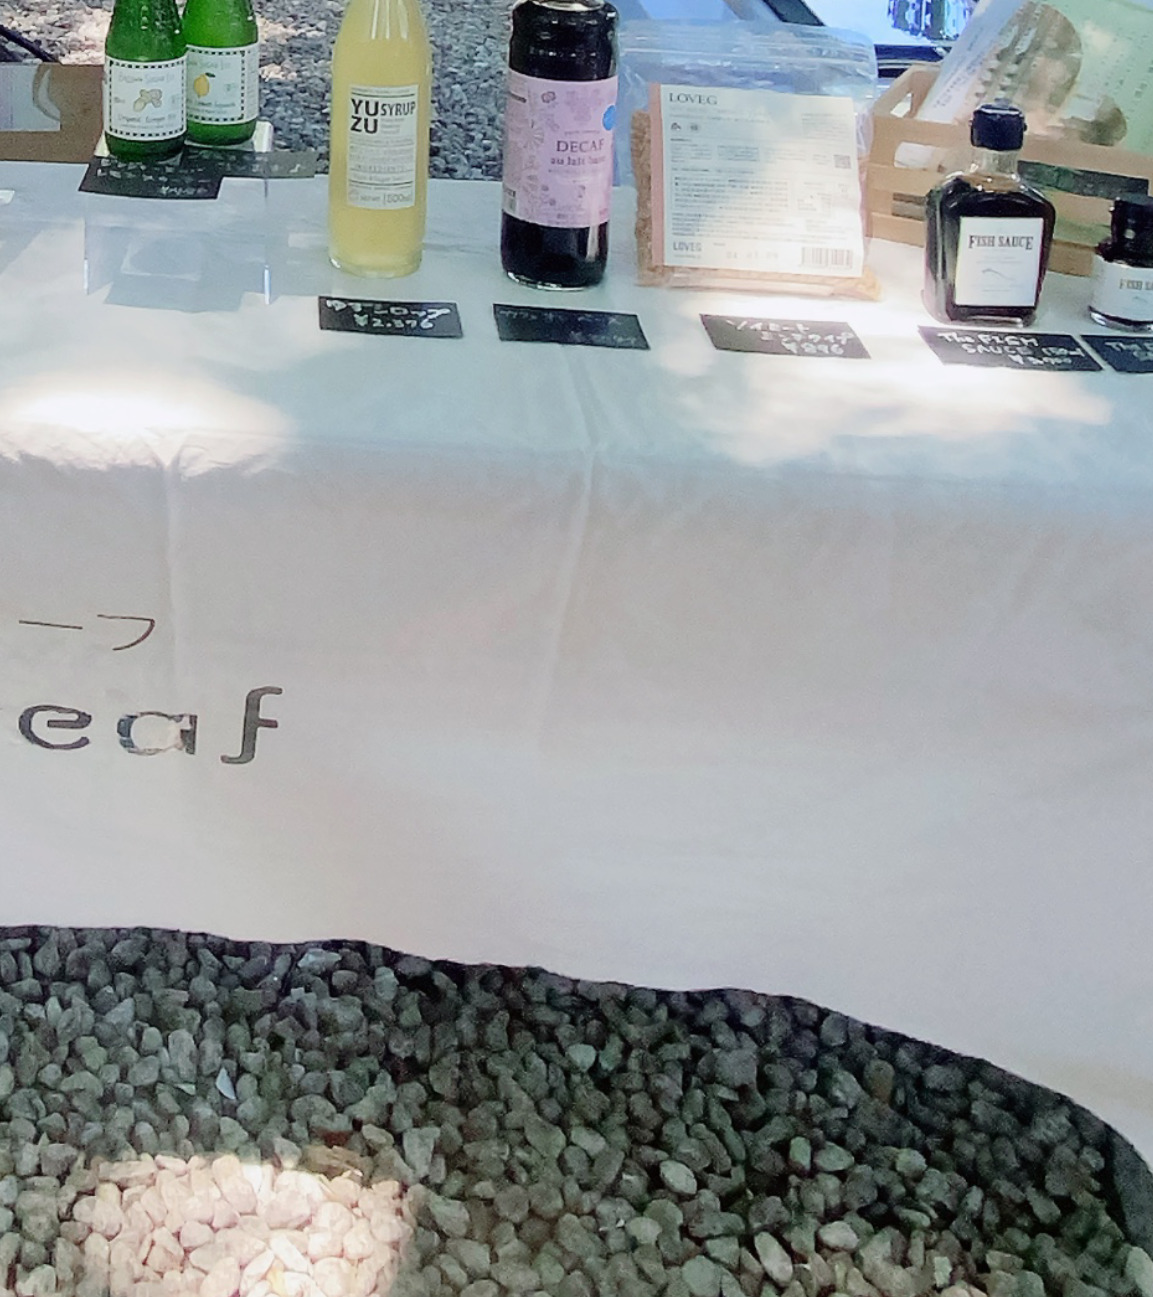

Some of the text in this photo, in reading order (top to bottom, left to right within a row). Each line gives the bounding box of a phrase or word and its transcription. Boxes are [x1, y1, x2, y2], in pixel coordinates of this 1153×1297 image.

[668, 92, 718, 105] LOVEG
[380, 101, 416, 116] SYRUP
[350, 115, 379, 134] ZU
[556, 138, 605, 153] DECAF
[968, 235, 1034, 250] FISH SAUCE
